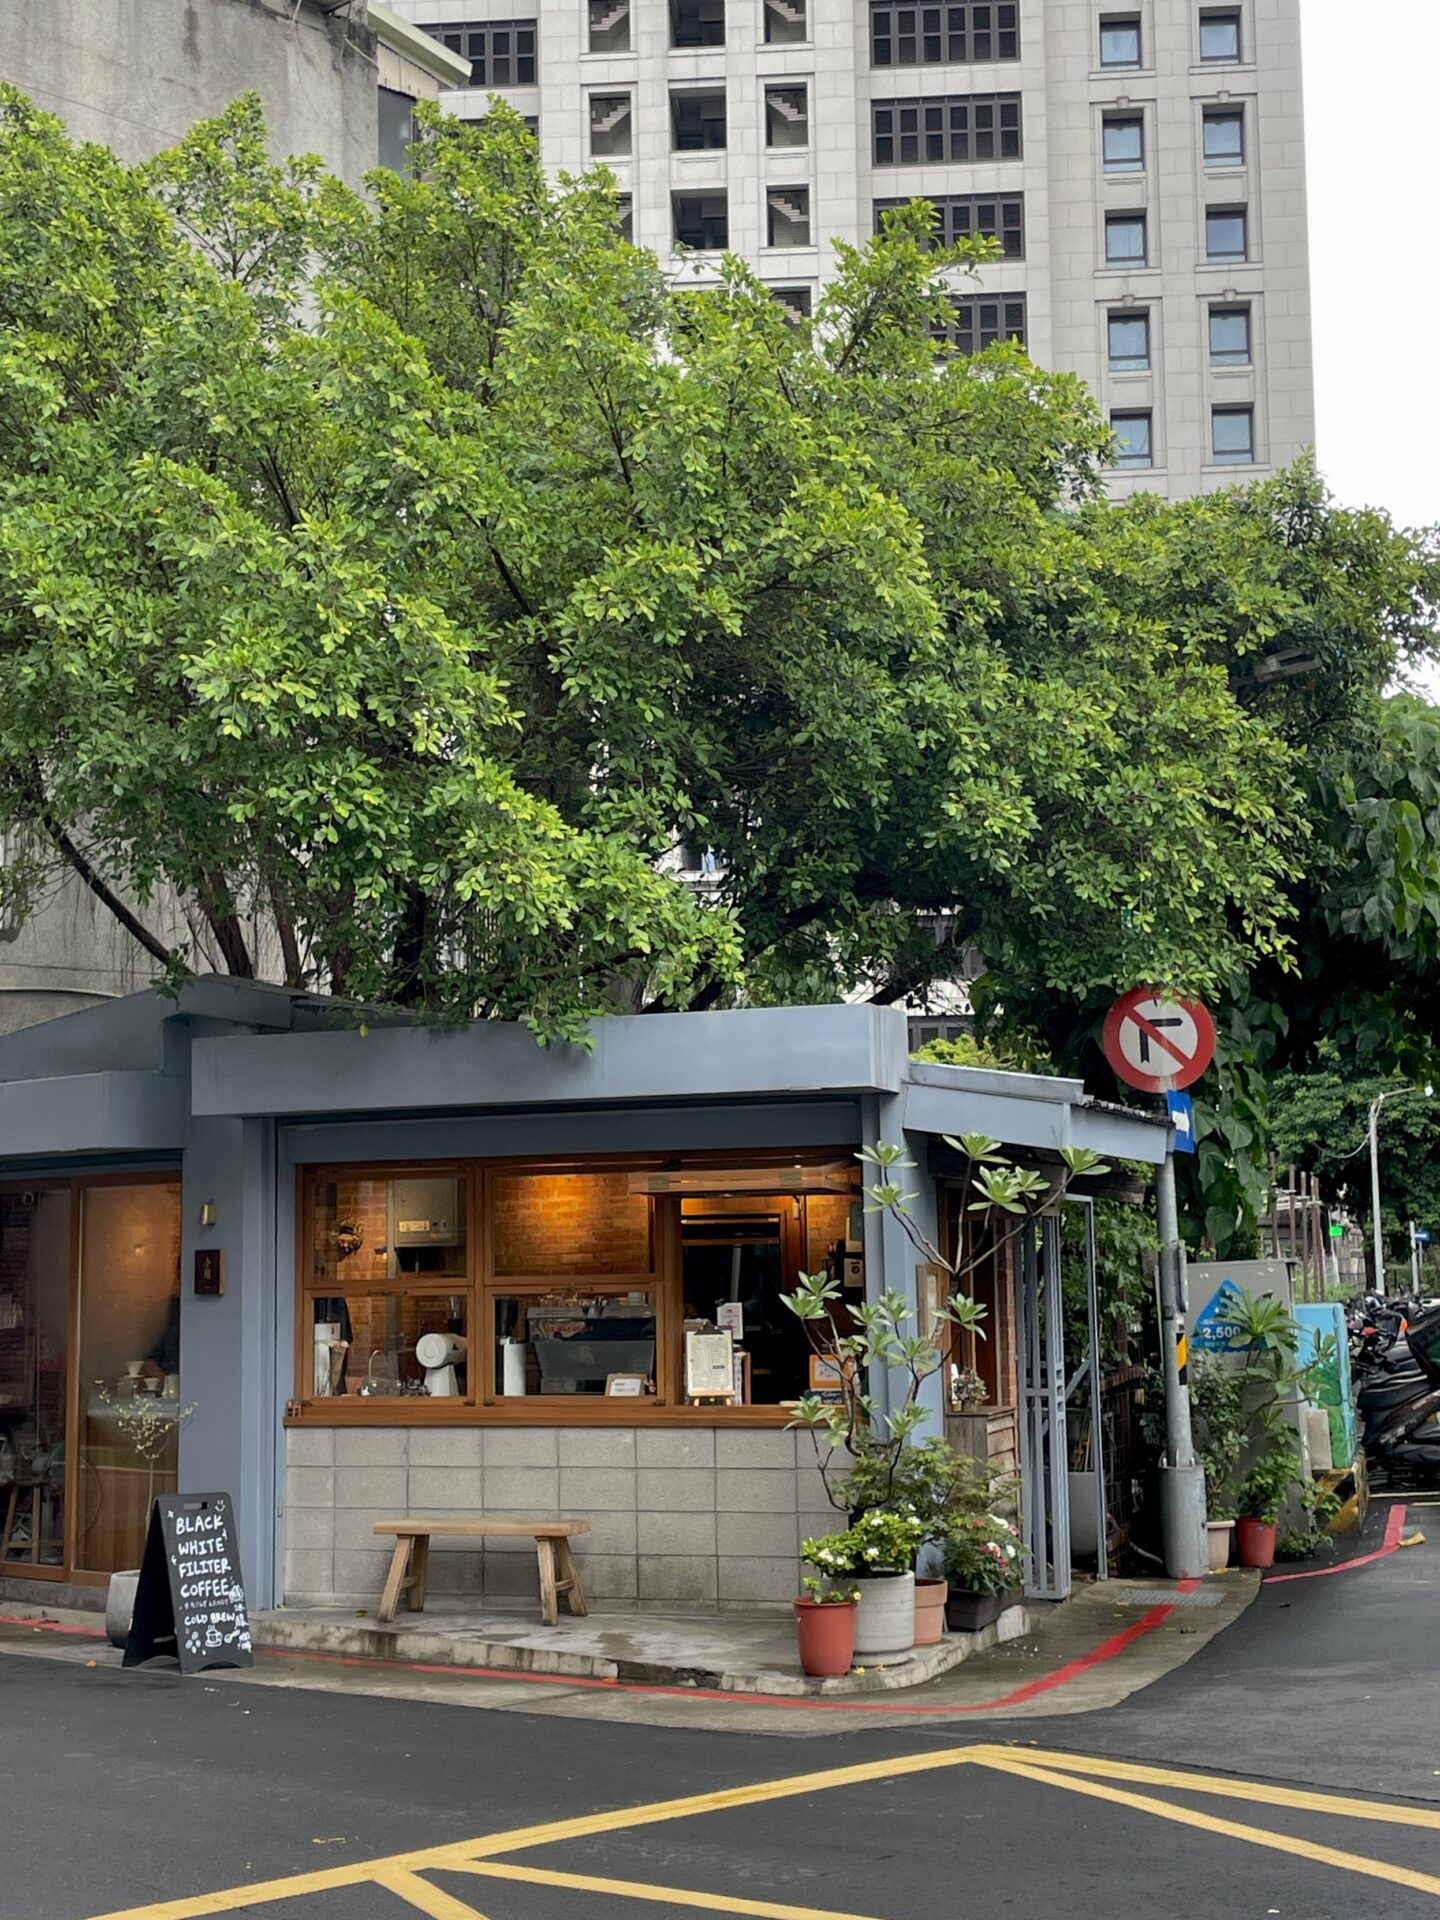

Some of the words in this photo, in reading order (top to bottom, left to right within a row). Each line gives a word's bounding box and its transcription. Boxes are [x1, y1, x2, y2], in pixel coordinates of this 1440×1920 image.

[176, 1514, 223, 1535] BLACK
[178, 1537, 224, 1555] WHITE
[179, 1558, 231, 1578] FILITER
[181, 1578, 229, 1598] COFFEE
[184, 1614, 208, 1625] COLD
[210, 1612, 235, 1624] BREW
